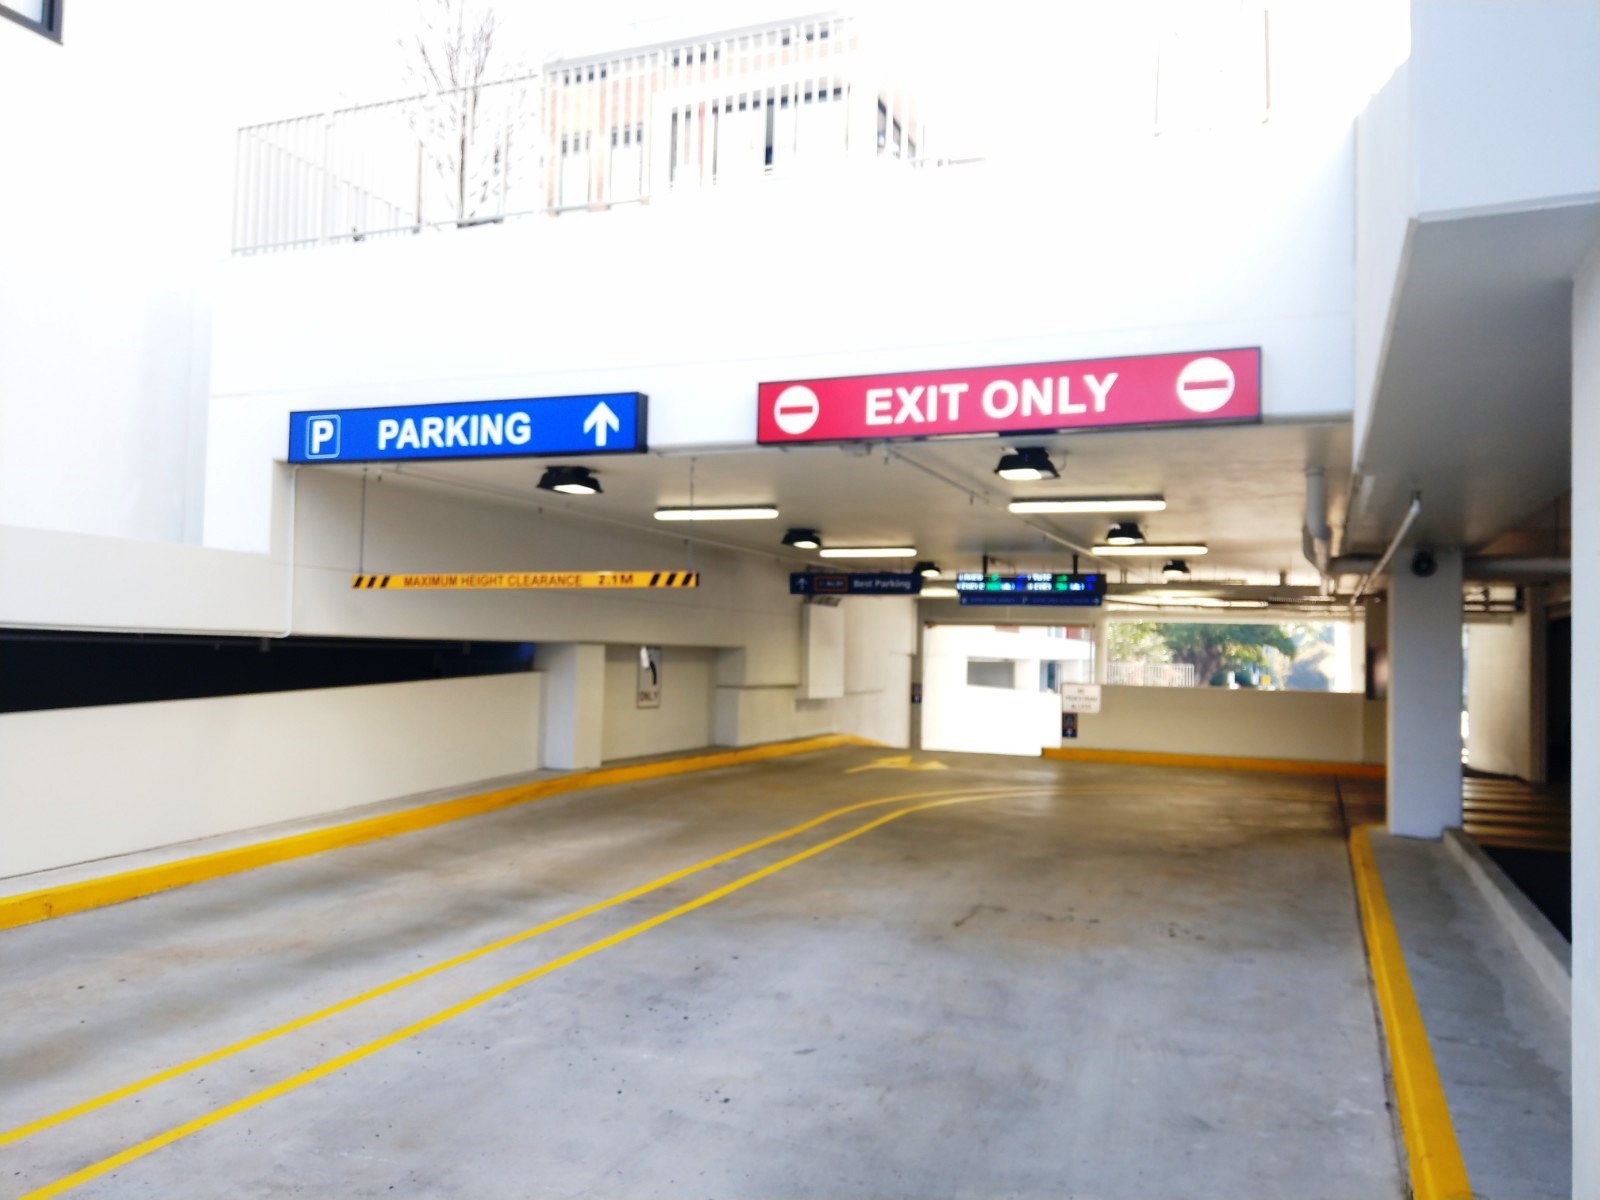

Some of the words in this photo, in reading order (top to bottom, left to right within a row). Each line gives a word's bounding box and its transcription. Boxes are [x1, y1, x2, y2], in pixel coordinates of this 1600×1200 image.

[865, 383, 969, 425] EXIT
[982, 372, 1119, 419] ONLY
[312, 420, 334, 454] P
[378, 411, 532, 451] PARKING
[404, 576, 458, 587] MAXIMUM
[461, 575, 502, 587] HEIGHT
[508, 574, 582, 587] CLEARANCE
[853, 579, 873, 589] Best
[874, 579, 912, 591] Parking
